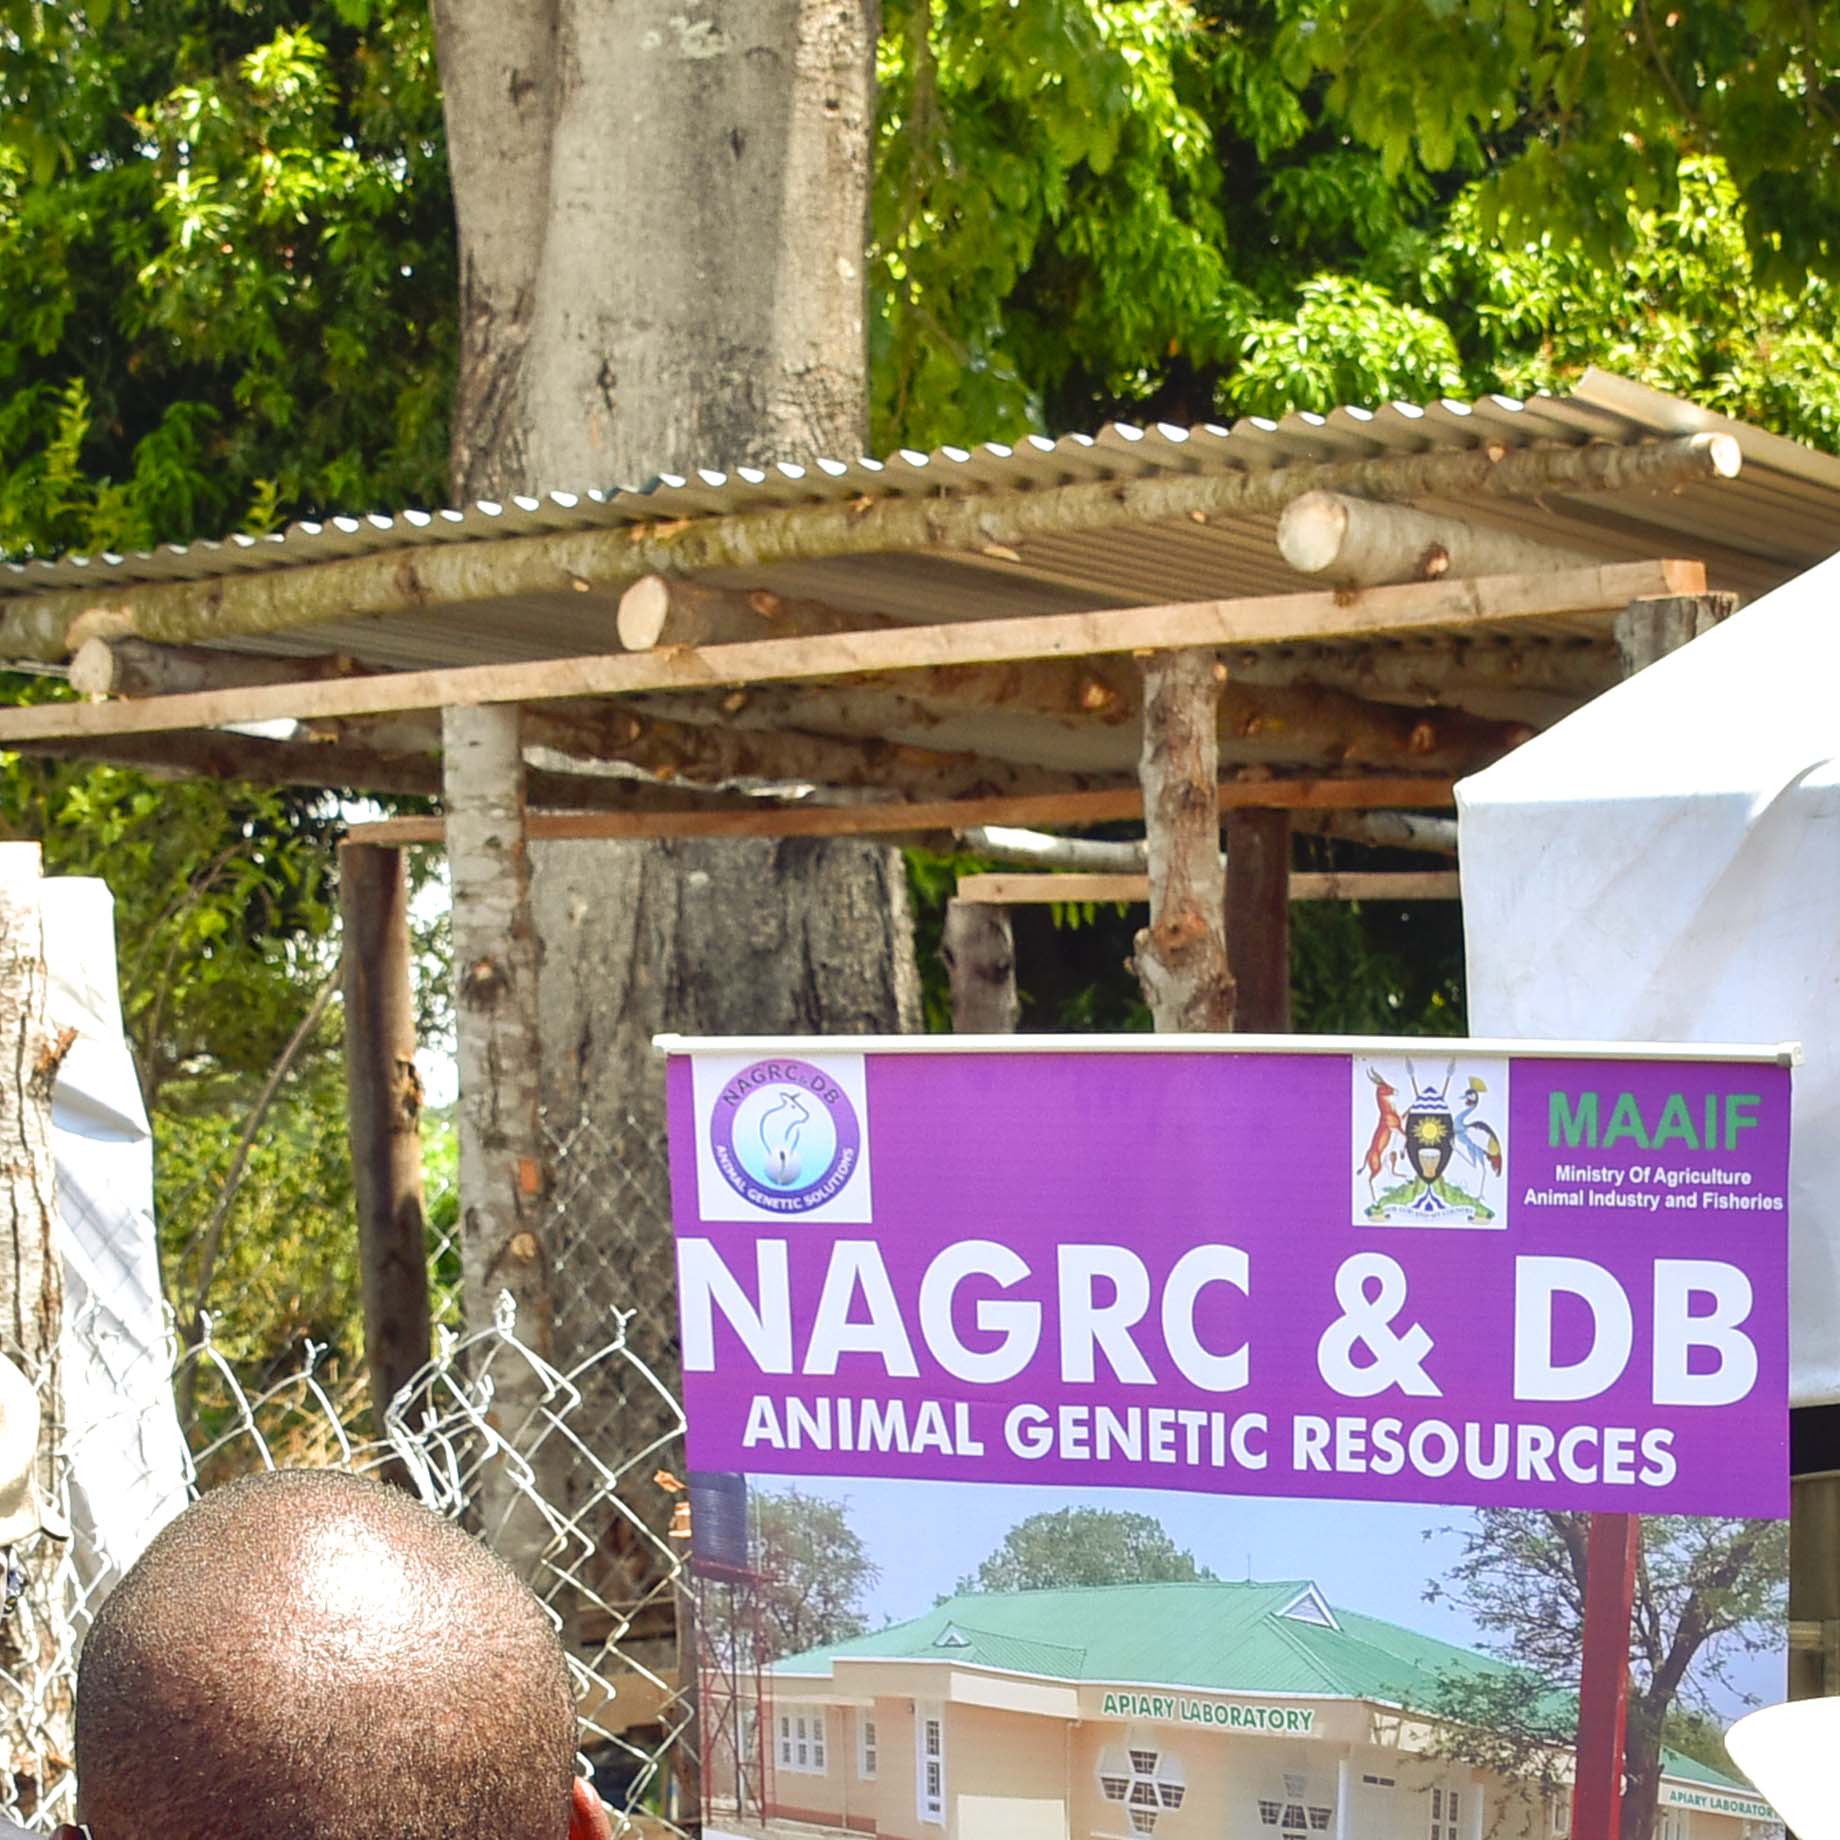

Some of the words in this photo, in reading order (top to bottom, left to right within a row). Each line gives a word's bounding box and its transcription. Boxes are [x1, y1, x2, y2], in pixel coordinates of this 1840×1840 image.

[1548, 1091, 1762, 1151] MAAIF
[1555, 1164, 1625, 1187] Ministry
[1629, 1165, 1652, 1185] Of
[1653, 1166, 1752, 1188] Agriculture
[1524, 1187, 1584, 1207] Animal
[1589, 1189, 1662, 1212] Industry
[1665, 1191, 1697, 1209] and
[1702, 1191, 1784, 1212] Fisheries
[677, 1237, 1253, 1393] NAGRC
[1316, 1252, 1444, 1397] &
[1513, 1254, 1759, 1407] DB
[742, 1396, 984, 1460] ANIMAL
[1005, 1403, 1269, 1474] GENETIC
[1293, 1413, 1677, 1488] RESOURCES
[1103, 1694, 1175, 1718] APIARY
[1180, 1703, 1313, 1732] LABORATORY
[1670, 1790, 1708, 1807] APIARY
